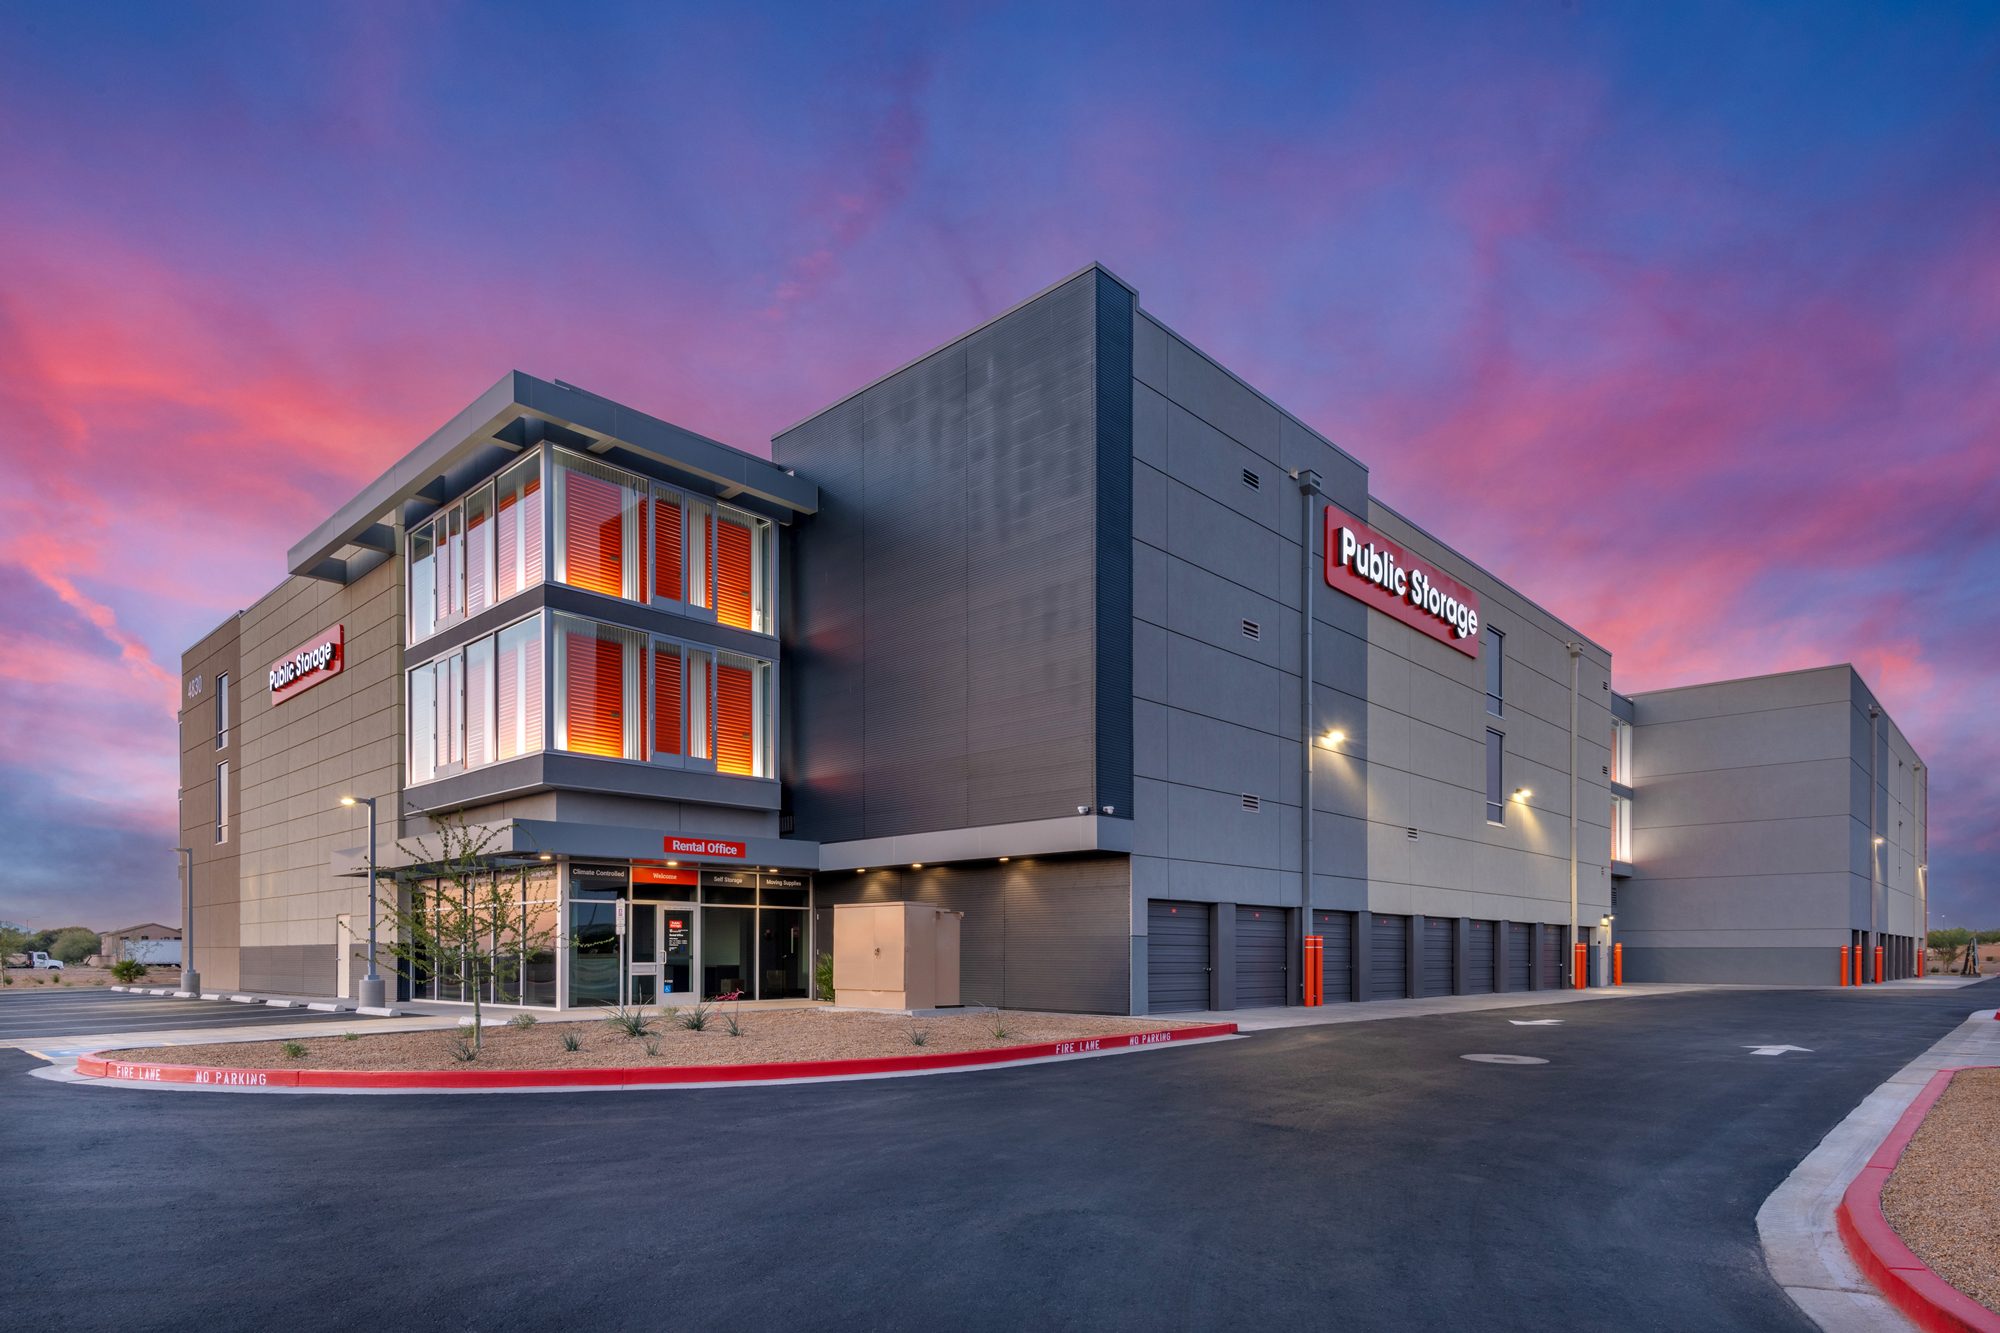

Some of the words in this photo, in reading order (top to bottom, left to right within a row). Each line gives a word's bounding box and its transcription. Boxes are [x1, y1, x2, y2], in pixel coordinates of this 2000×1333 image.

[1341, 527, 1407, 596] Public
[1409, 569, 1478, 639] Storage
[269, 661, 295, 692] Public
[296, 641, 332, 676] Storage
[672, 841, 705, 853] Rental
[707, 843, 739, 855] Office
[572, 868, 595, 876] Climate
[596, 869, 625, 878] Controlled
[652, 872, 677, 880] Welcome
[713, 875, 724, 883] Self
[724, 876, 743, 885] Storage
[766, 879, 782, 887] Moving
[783, 879, 802, 887] Supplies
[1129, 1035, 1139, 1045] NO
[1142, 1032, 1171, 1042] PARKING
[1055, 1042, 1074, 1054] FIRE
[1079, 1040, 1100, 1051] LANE
[116, 1065, 134, 1078] FIRE
[138, 1067, 161, 1081] LANE
[195, 1071, 210, 1083] NO
[215, 1072, 267, 1086] PARKING
